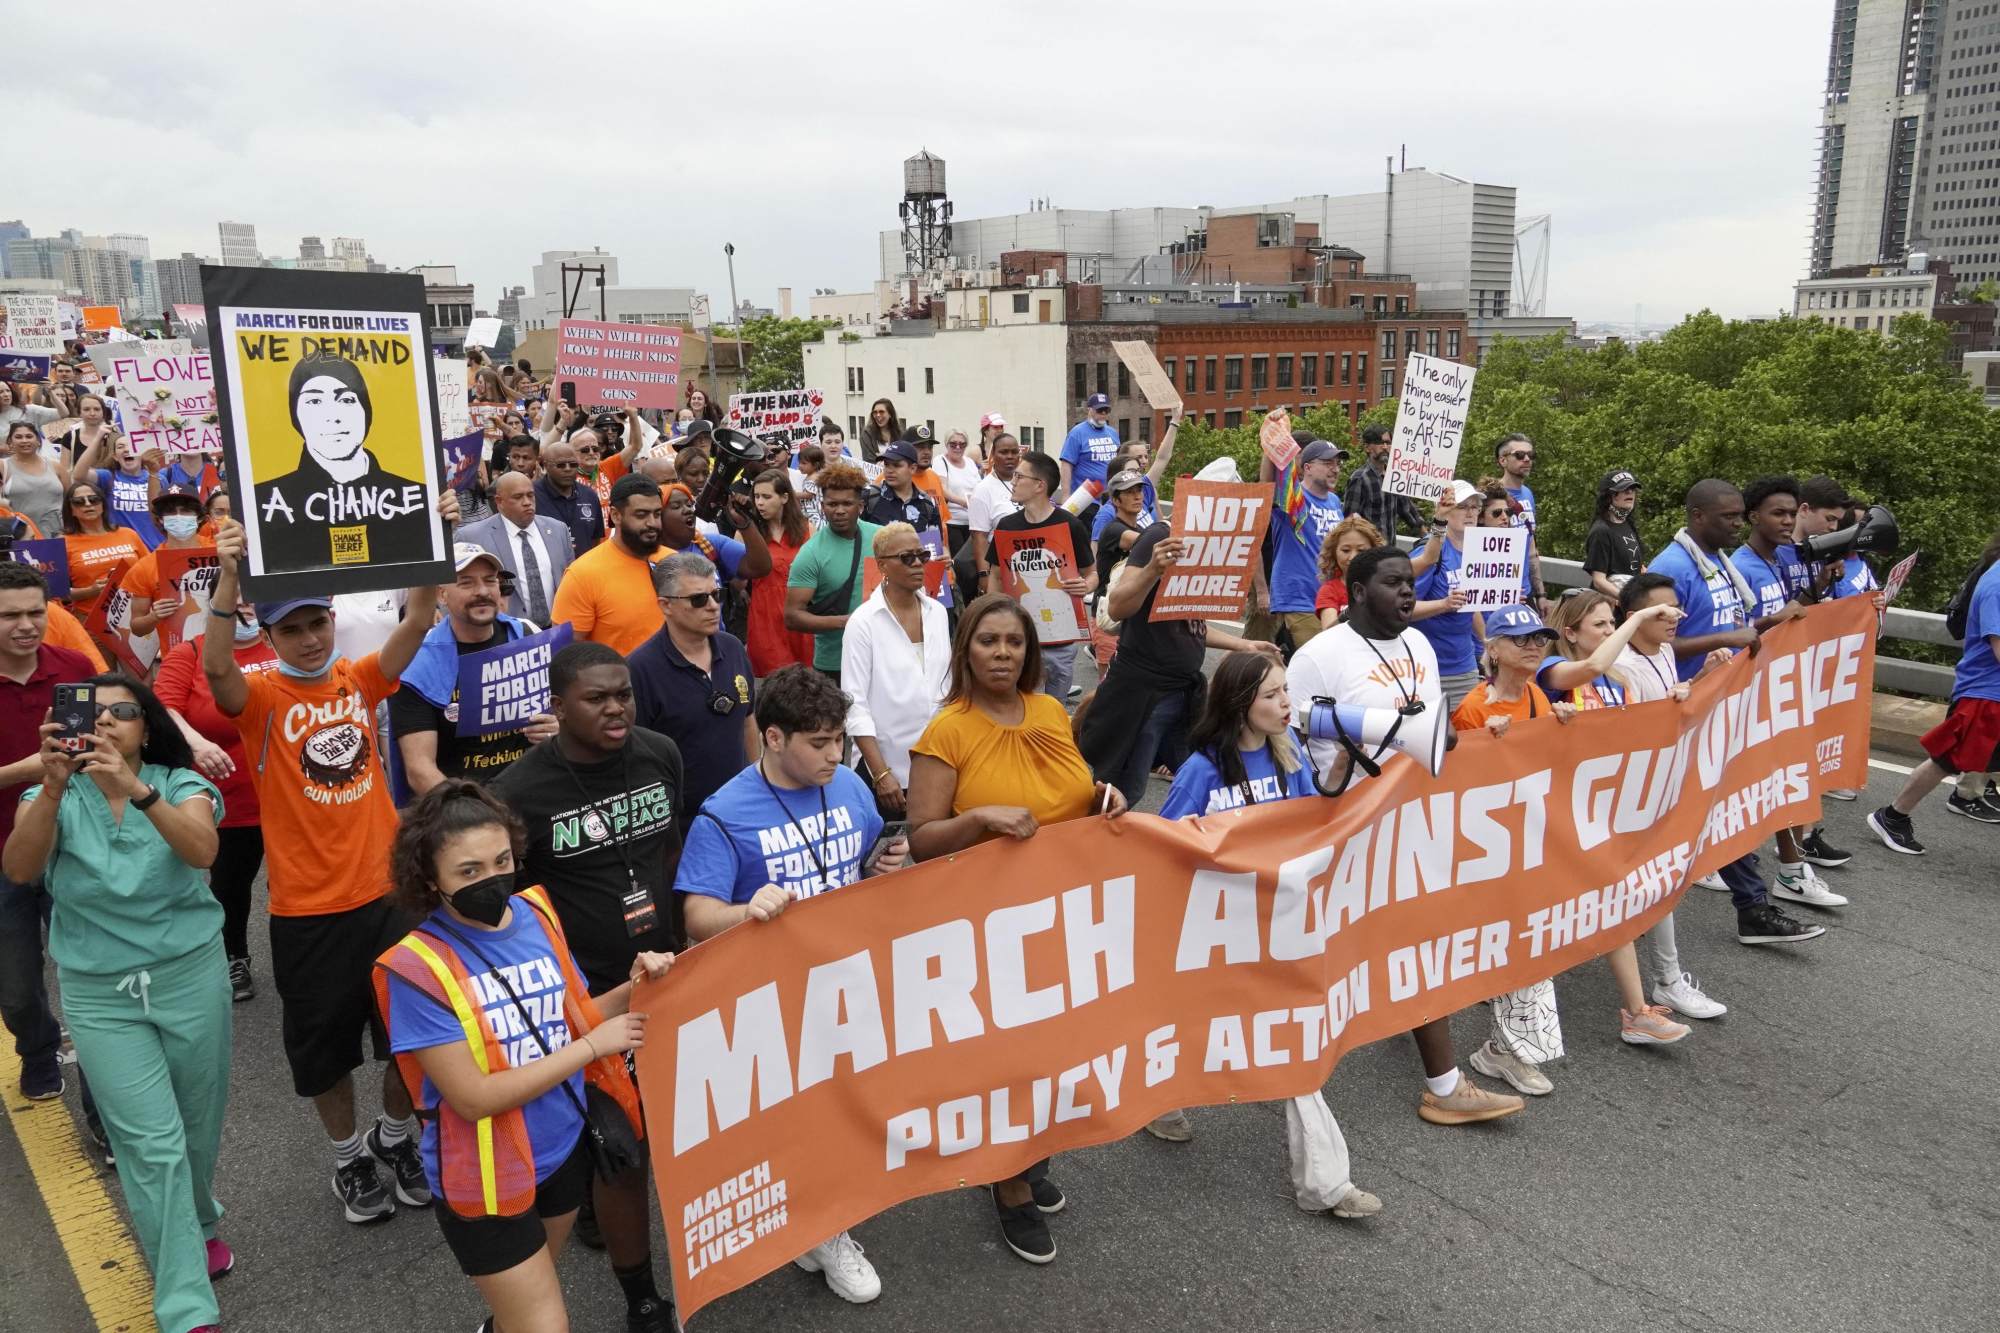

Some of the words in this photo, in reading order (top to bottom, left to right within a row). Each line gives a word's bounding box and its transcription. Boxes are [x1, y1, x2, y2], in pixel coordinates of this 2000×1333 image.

[20, 327, 56, 337] REPUBLICAN
[34, 317, 47, 326] GUN
[236, 313, 296, 328] MARCH
[300, 315, 333, 329] FOR
[333, 316, 365, 330] OUR
[366, 317, 409, 331] LIVES
[566, 327, 604, 340] WHEN
[609, 330, 640, 342] WILL
[646, 334, 679, 346] THEY
[240, 334, 290, 362] WE
[301, 336, 410, 365] DEMAND
[564, 344, 599, 356] LOVE
[606, 348, 642, 361] THEIR
[646, 351, 677, 363] KIDS
[561, 365, 599, 377] MORE
[604, 368, 638, 381] THAN
[640, 372, 677, 385] THEIR
[1413, 355, 1440, 382] The
[1441, 366, 1468, 397] only
[602, 388, 637, 400] GUNS
[1405, 376, 1431, 407] thing
[1434, 391, 1466, 407] easier
[175, 395, 207, 410] NOT
[741, 396, 776, 412] THE
[780, 393, 809, 409] NRA
[740, 415, 762, 429] HAS
[765, 412, 800, 427] BLOOD
[1404, 398, 1416, 416] to
[1420, 401, 1440, 429] buy
[1439, 409, 1463, 431] than
[791, 425, 817, 440] HANDS
[1402, 425, 1413, 436] an
[1412, 422, 1460, 449] AR-15
[1405, 439, 1417, 453] is
[1423, 447, 1430, 457] a
[1391, 448, 1454, 481] Republican
[113, 500, 149, 512] LIVES
[262, 487, 295, 524] A
[305, 483, 425, 524] CHANGE
[1184, 495, 1265, 532] NOT
[81, 543, 134, 562] ENOUGH
[1013, 536, 1046, 550] STOP
[1176, 536, 1256, 567] ONE
[1482, 536, 1511, 553] LOVE
[1004, 553, 1068, 573] Violence!
[1020, 549, 1042, 562] GUN
[1466, 562, 1521, 579] CHILDREN
[1163, 575, 1246, 598] MORE.
[1156, 604, 1239, 614] #MARCHFOROURLIVES
[481, 643, 552, 684] MARCH
[1367, 658, 1426, 688] YOUTH
[481, 676, 526, 706] FOR
[481, 694, 542, 725] LIVES
[312, 725, 354, 753] CHANGE
[320, 745, 342, 760] THE
[303, 785, 333, 805] GUN
[551, 808, 580, 821] NATIONAL
[758, 806, 853, 856] MARCH
[766, 846, 819, 881] FOR
[818, 830, 862, 867] OUR
[673, 874, 1136, 1158] MARCH
[1175, 769, 1552, 972] AGAINST
[1571, 726, 1698, 852] GUN
[886, 1044, 1128, 1172] POLICY
[1145, 1023, 1180, 1088] &
[1387, 919, 1511, 1002] OVER
[1519, 841, 1692, 959] THOUGHTS
[486, 1003, 530, 1040] OR
[683, 1160, 771, 1229] MARCH
[685, 1206, 733, 1255] FOR
[736, 1179, 788, 1224] OUR
[687, 1221, 754, 1280] LIVES
